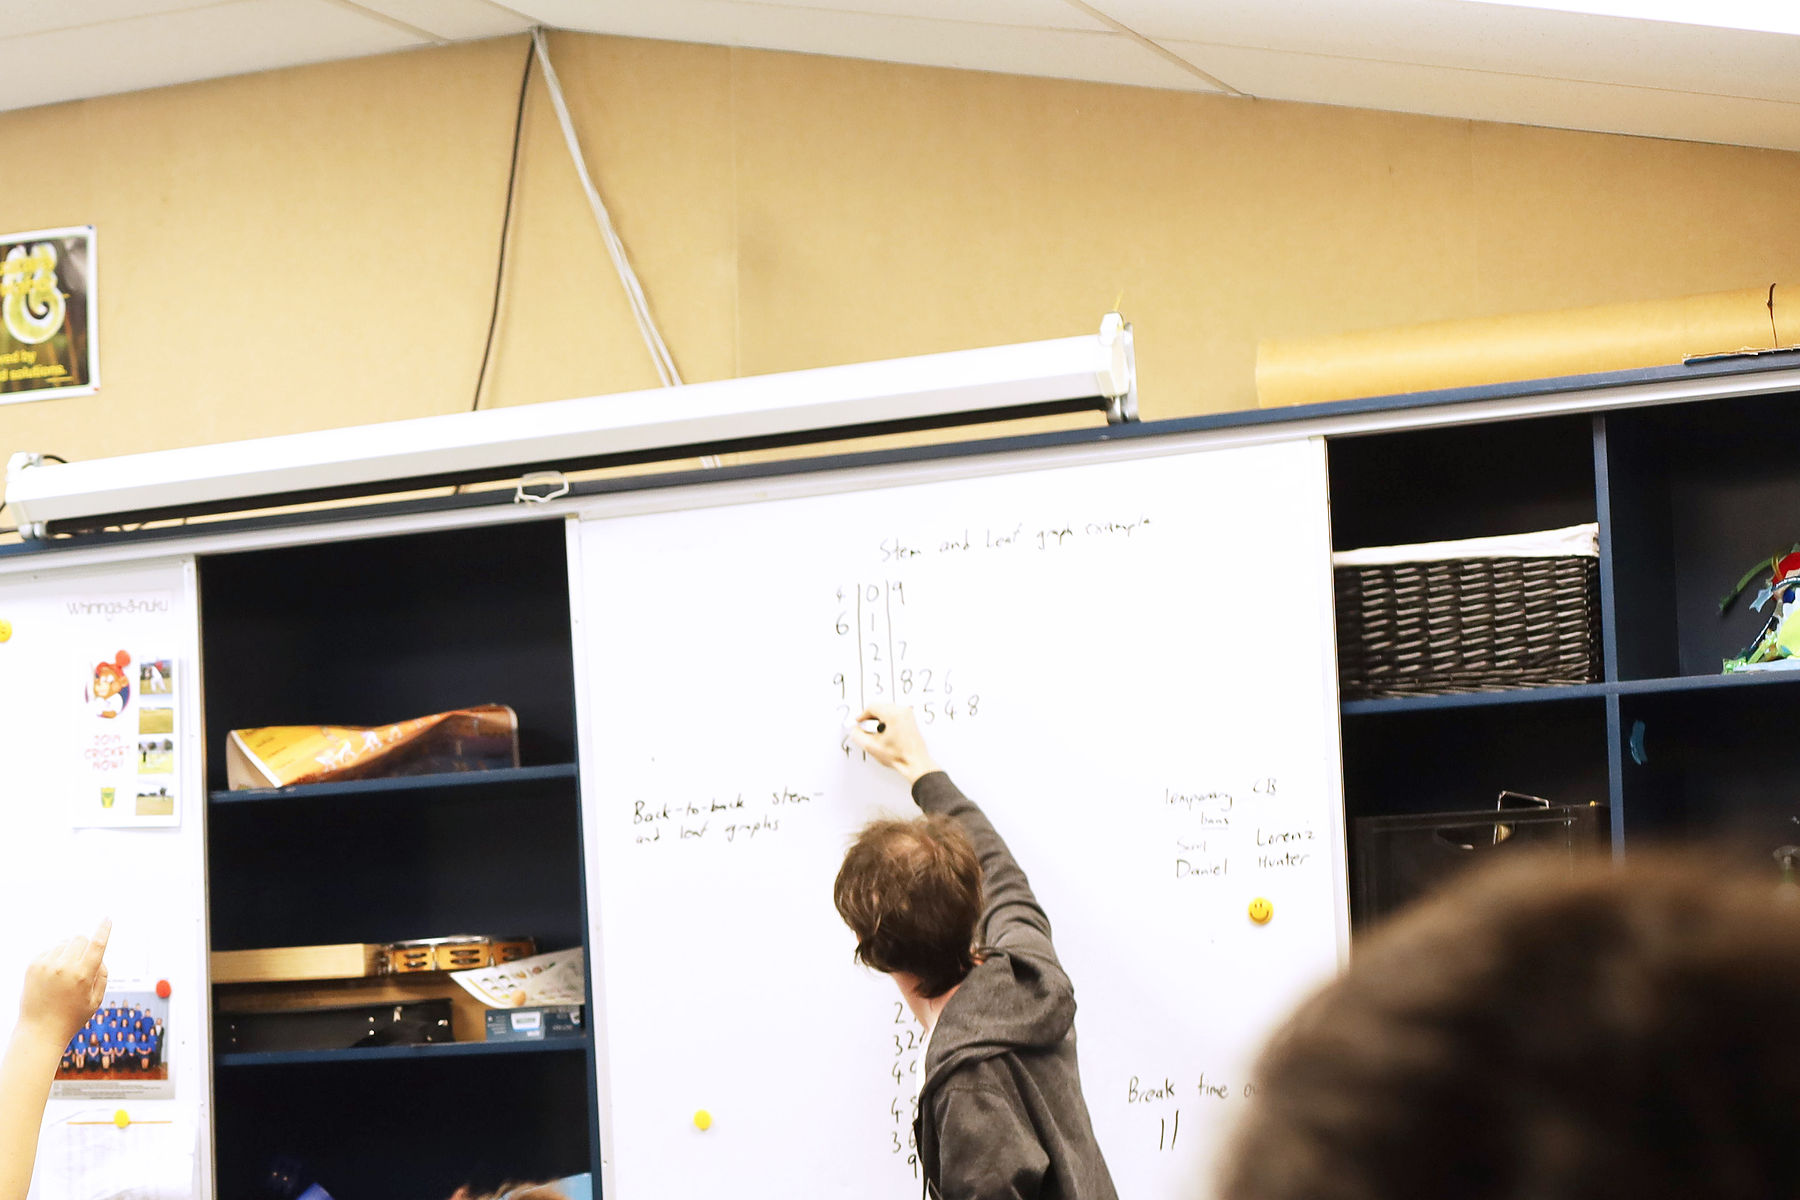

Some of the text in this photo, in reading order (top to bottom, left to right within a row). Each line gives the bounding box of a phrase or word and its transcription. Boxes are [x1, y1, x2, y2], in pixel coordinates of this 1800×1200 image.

[892, 581, 905, 605] 9
[836, 611, 849, 635] 6
[869, 640, 907, 661] 2 7
[833, 673, 845, 699] 9
[874, 672, 884, 695] 3
[900, 668, 913, 694] 8
[919, 668, 934, 693] 2
[924, 703, 935, 725] 5
[945, 699, 957, 720] 4
[968, 695, 980, 716] 8
[636, 827, 660, 844] and
[1176, 858, 1227, 878] Daniel
[1129, 1076, 1176, 1103] Break
[1198, 1072, 1229, 1099] time
[907, 1154, 917, 1179] 9
